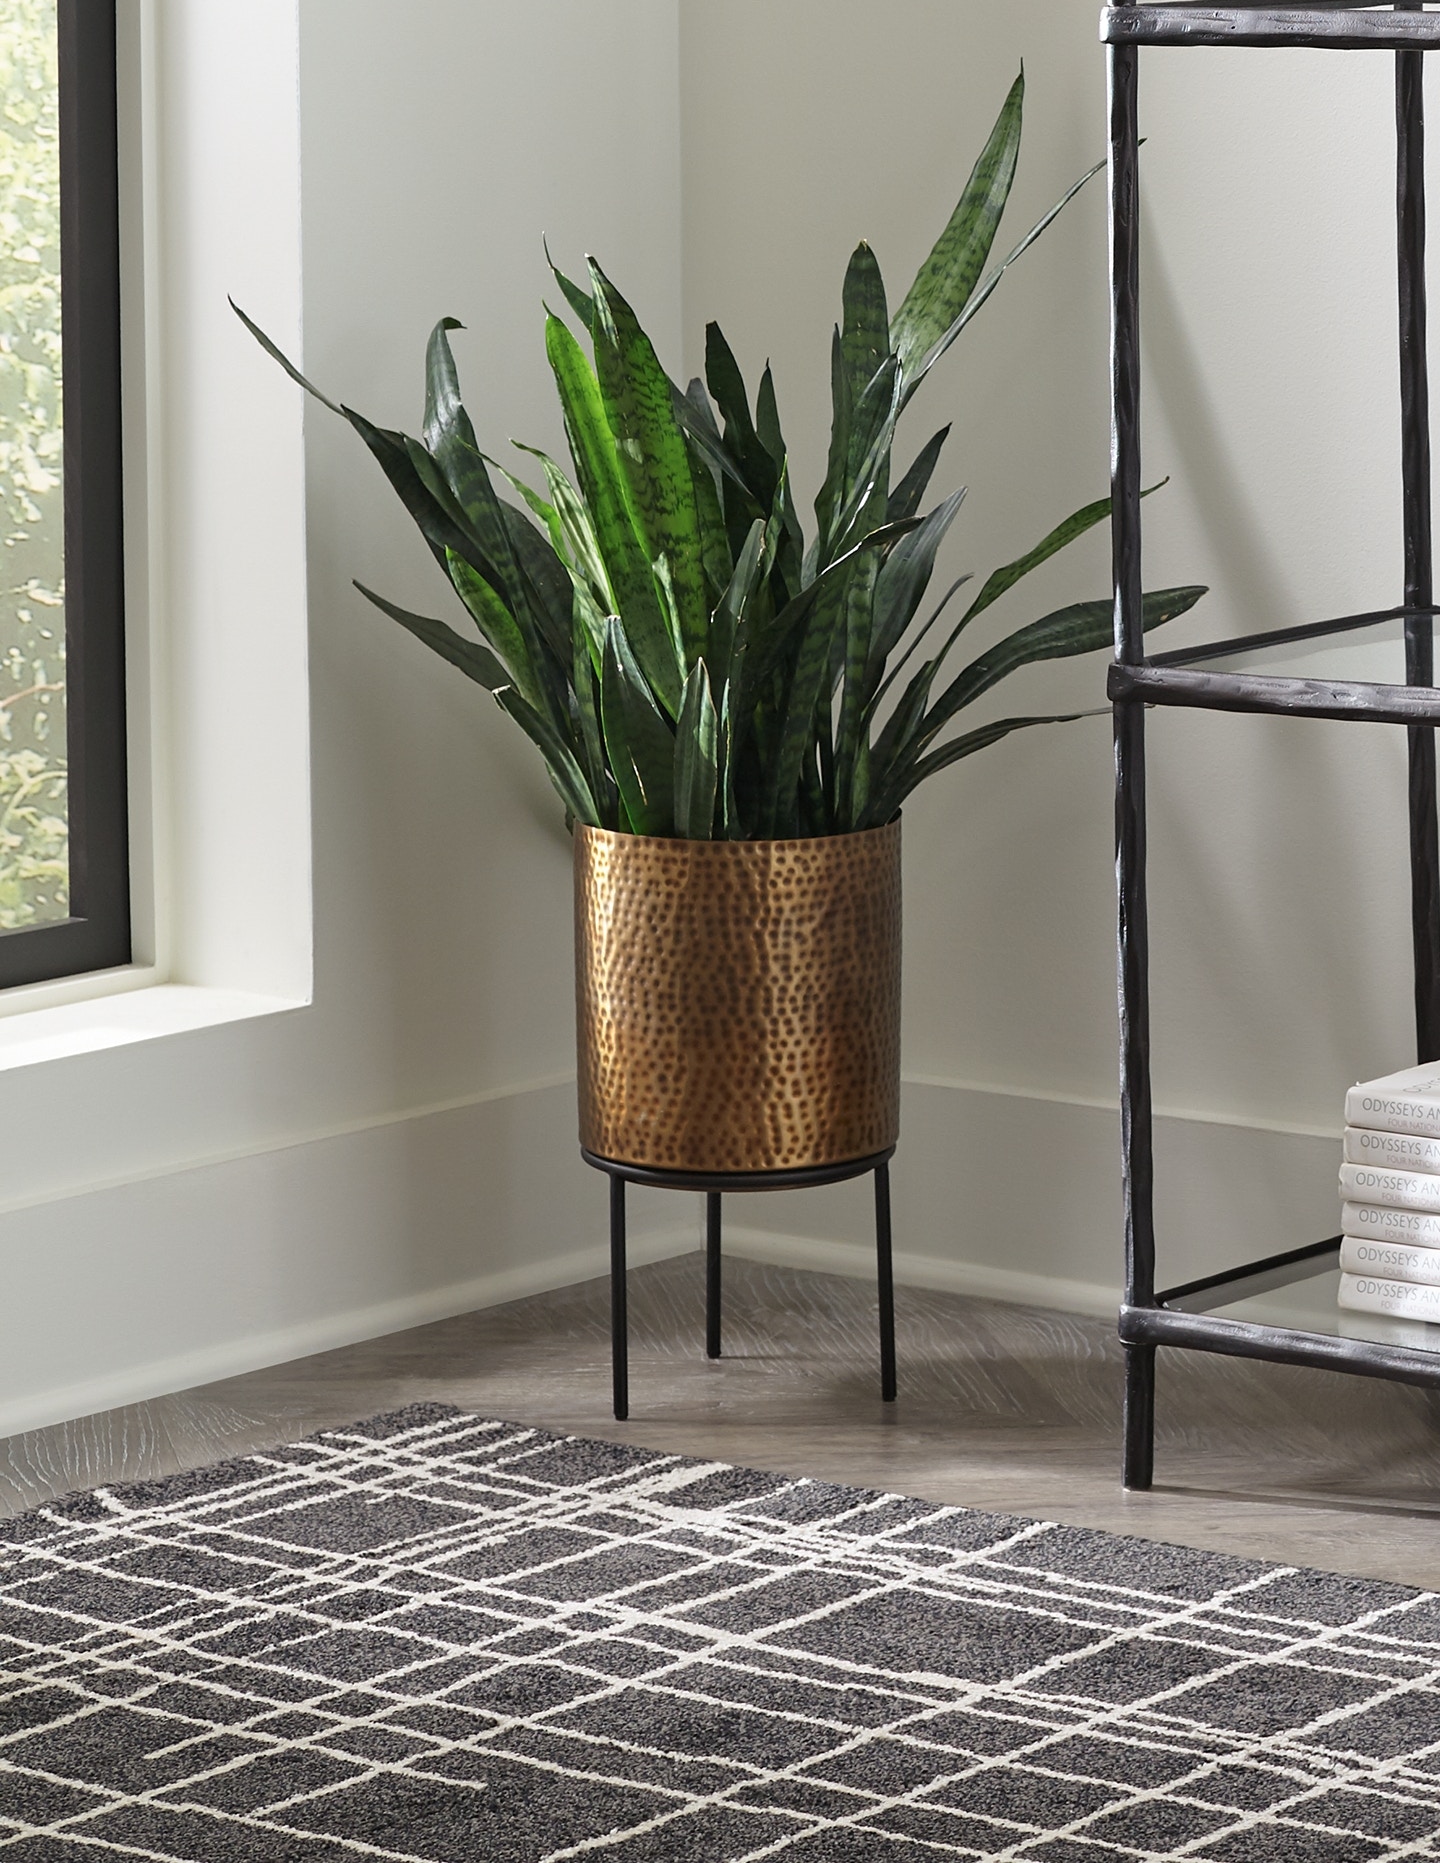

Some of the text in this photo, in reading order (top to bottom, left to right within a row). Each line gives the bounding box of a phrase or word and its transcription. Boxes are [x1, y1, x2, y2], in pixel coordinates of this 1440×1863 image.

[1362, 1097, 1424, 1119] ODYSSEYS
[1360, 1134, 1421, 1156] ODYSSEYS
[1355, 1172, 1418, 1193] ODYSSEYS
[1358, 1209, 1420, 1230] ODYSSEYS
[1357, 1246, 1419, 1267] ODYSSEYS
[1356, 1280, 1418, 1301] ODYSSEYS
